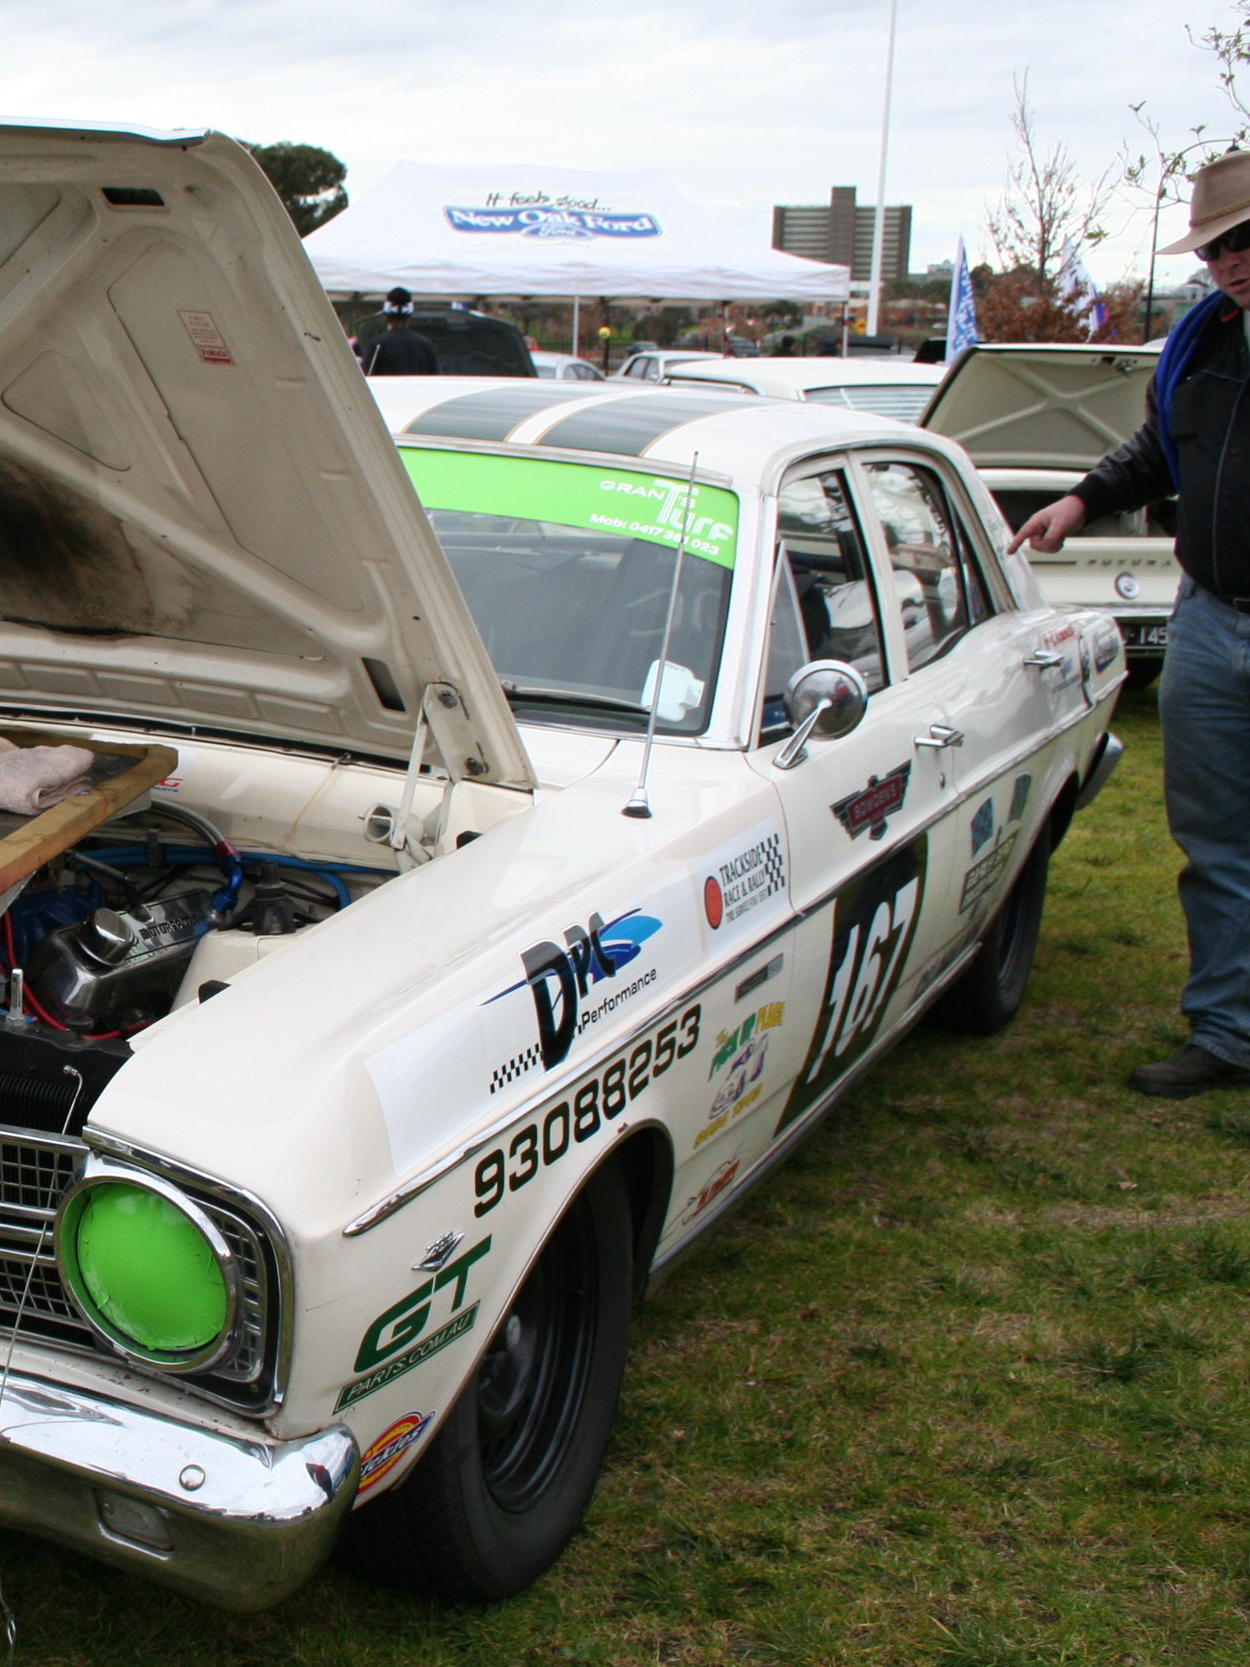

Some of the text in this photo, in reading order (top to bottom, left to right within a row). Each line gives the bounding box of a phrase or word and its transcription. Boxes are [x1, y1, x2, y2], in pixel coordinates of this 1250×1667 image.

[451, 209, 655, 234] New Oak Ford
[486, 192, 503, 207] It
[509, 190, 550, 206] feels
[589, 513, 627, 529] Mob:
[629, 521, 664, 537] 0417
[690, 538, 720, 556] 023
[718, 844, 763, 887] TRACKSIDE
[724, 884, 741, 908] RACE
[741, 881, 748, 897] &
[581, 968, 658, 1031] Performance
[806, 876, 919, 1084] 167
[474, 1003, 702, 1218] 93088253
[353, 1233, 493, 1373] GT
[359, 1422, 426, 1478] ickies
